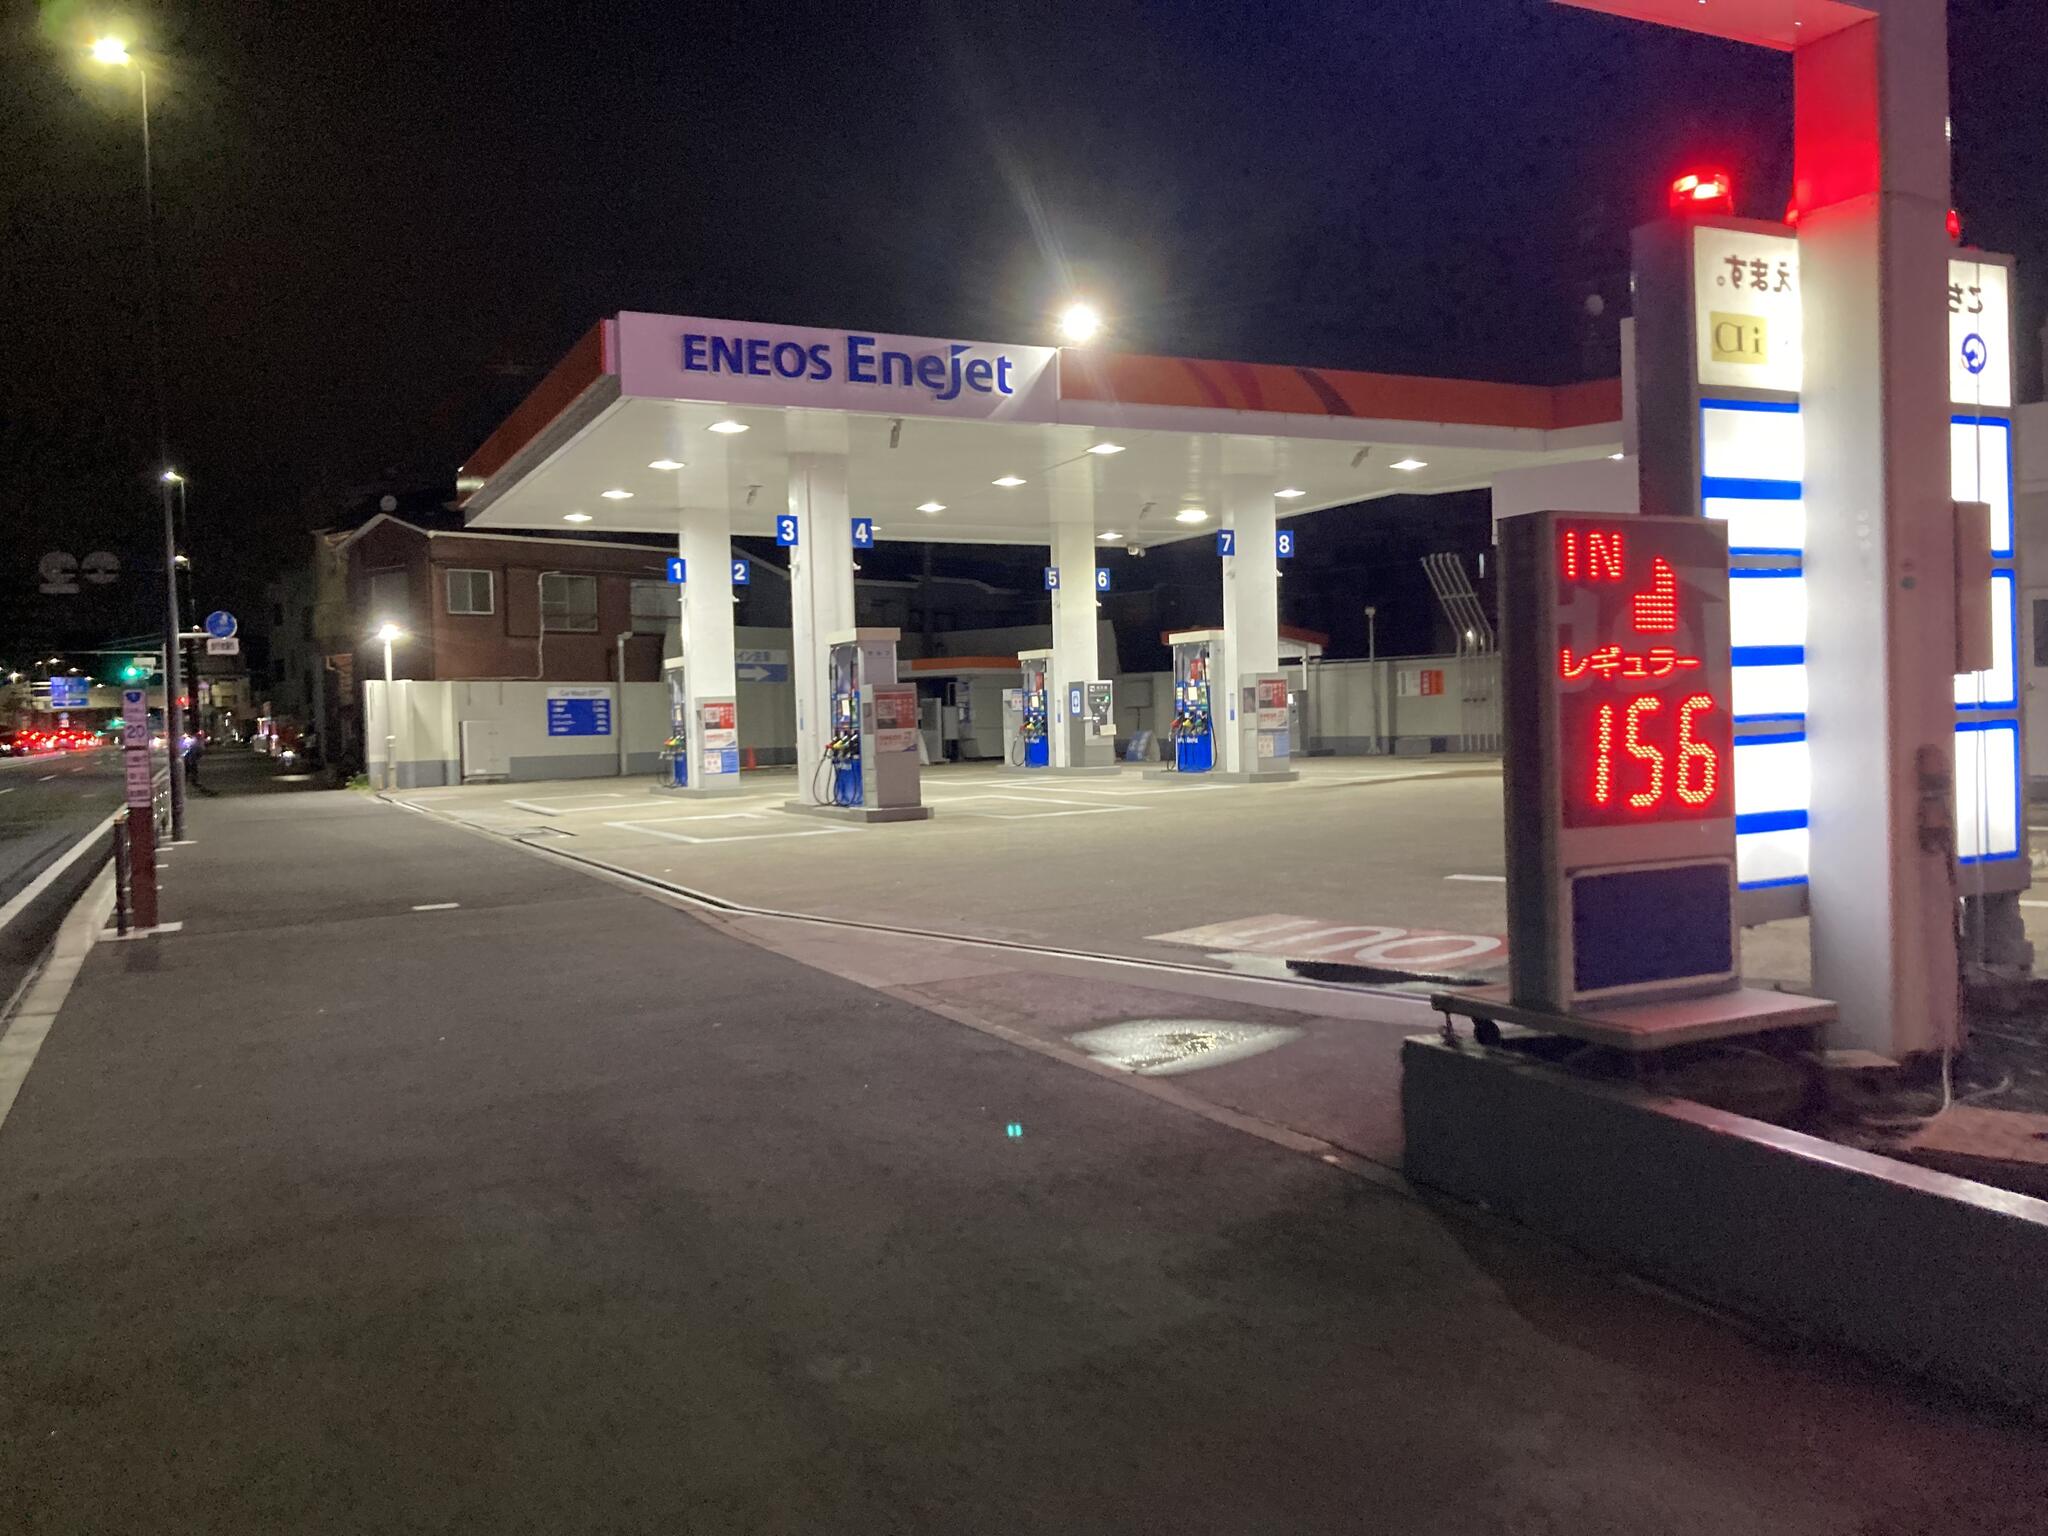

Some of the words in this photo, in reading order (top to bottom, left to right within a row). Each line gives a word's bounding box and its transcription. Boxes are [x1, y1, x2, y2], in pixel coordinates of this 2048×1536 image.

[683, 334, 832, 382] ENEOS
[847, 335, 1014, 401] Enejet
[781, 519, 795, 541] 3
[855, 523, 868, 543] 4
[1221, 534, 1232, 552] 7
[1278, 535, 1290, 553] 8
[1565, 531, 1624, 579] IN
[672, 562, 682, 579] 1
[734, 563, 746, 581] 2
[1048, 570, 1057, 587] 5
[1097, 571, 1108, 587] 6
[1562, 646, 1700, 681] レギュラー
[127, 725, 145, 738] 20
[1594, 692, 1719, 809] 156
